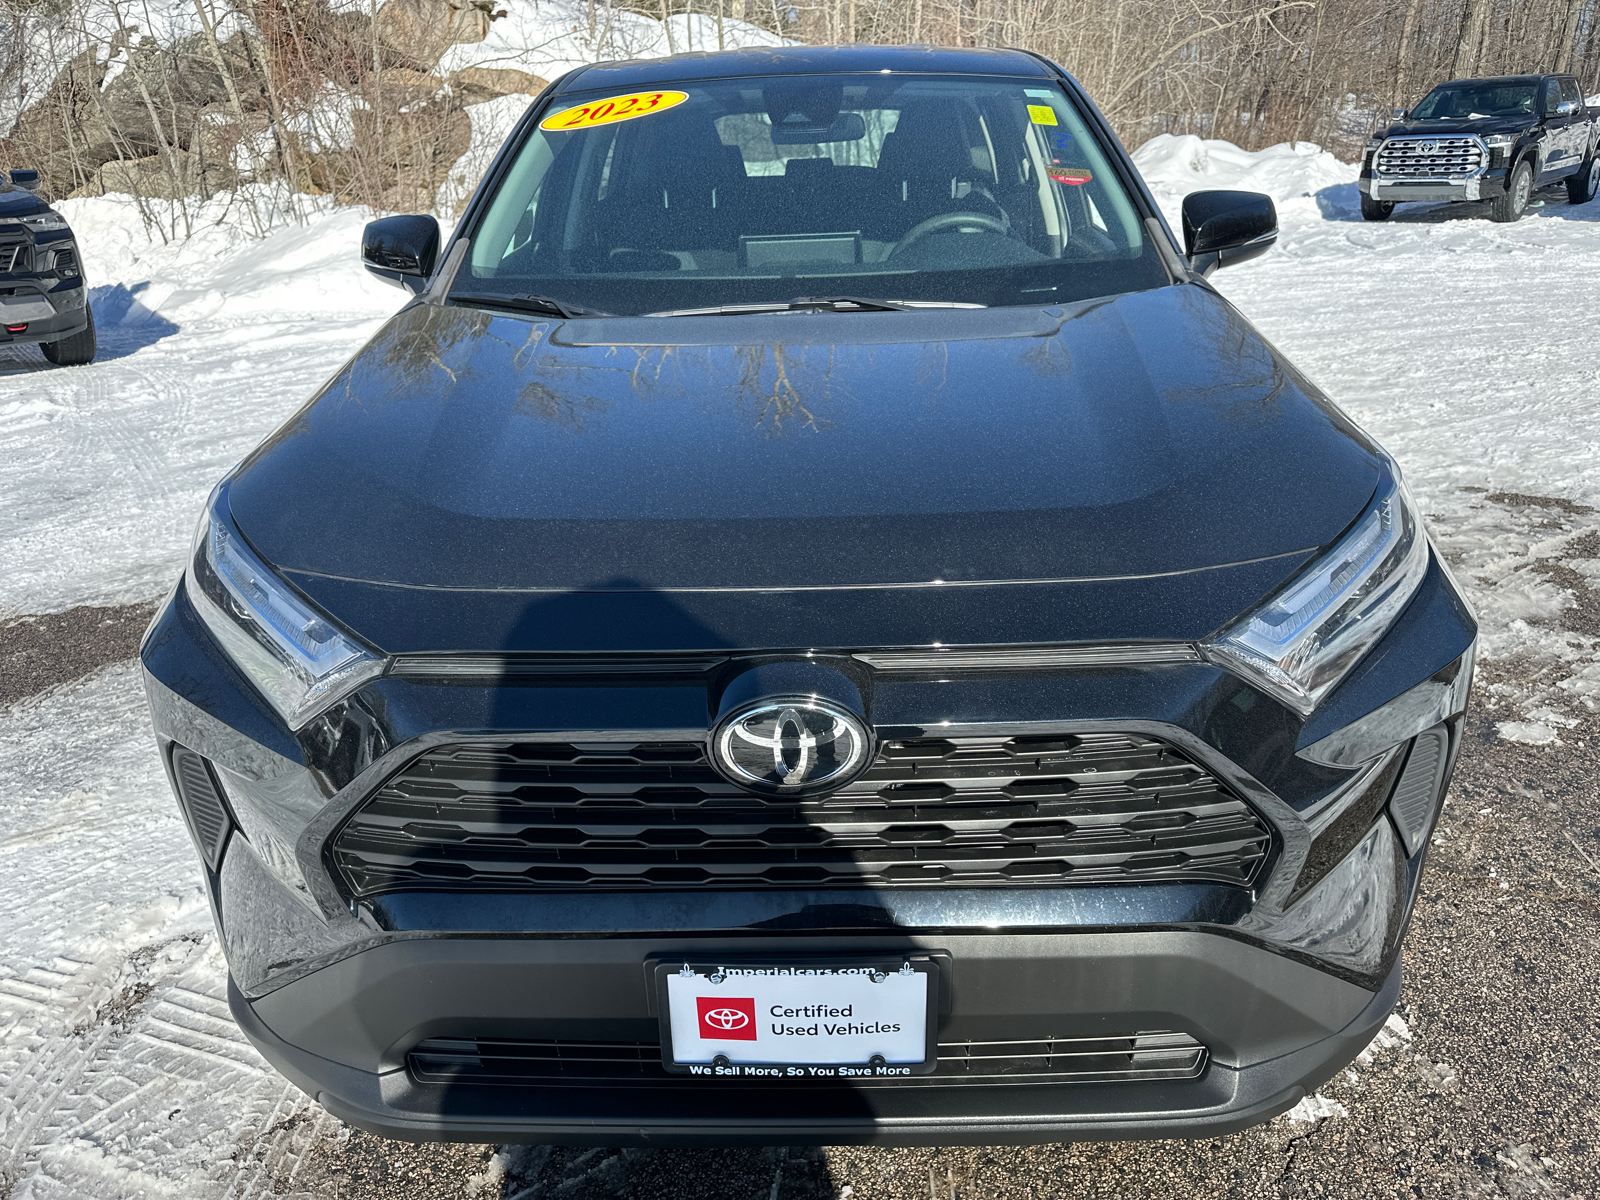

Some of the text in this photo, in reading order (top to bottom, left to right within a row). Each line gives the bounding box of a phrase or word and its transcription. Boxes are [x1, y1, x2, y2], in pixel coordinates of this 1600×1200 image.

[563, 94, 663, 127] 2023
[717, 966, 876, 977] Imperialcars.com
[770, 1004, 853, 1018] Certified
[771, 1022, 901, 1036] Used Vehicles
[690, 1066, 911, 1077] We Sell More, So You Save More
